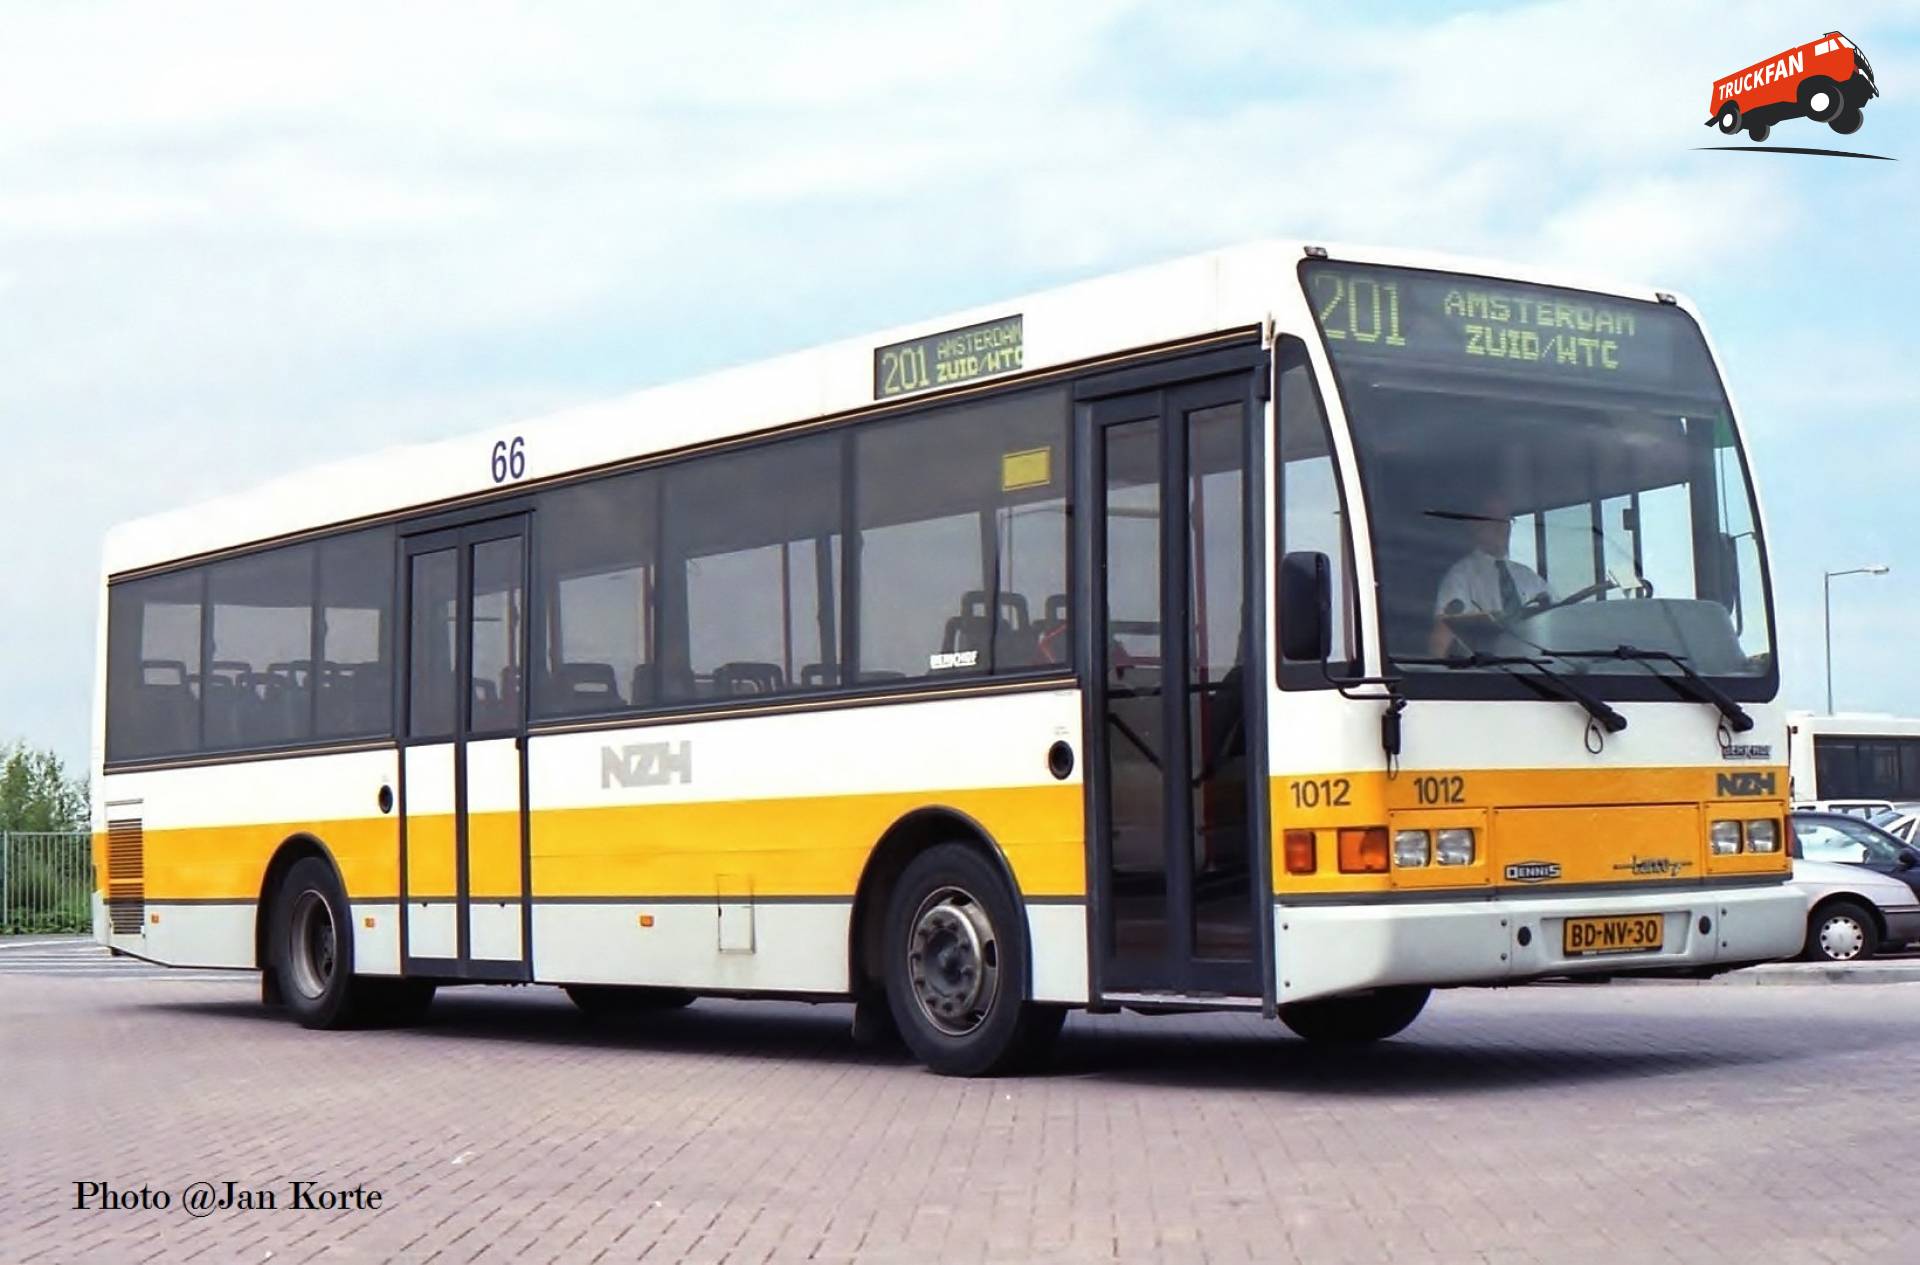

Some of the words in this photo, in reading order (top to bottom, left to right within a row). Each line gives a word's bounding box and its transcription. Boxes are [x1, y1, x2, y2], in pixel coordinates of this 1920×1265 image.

[1312, 270, 1406, 347] 201
[1443, 290, 1635, 336] AMSTERDAM
[882, 345, 930, 394] 201
[1464, 324, 1620, 370] ZUID/WTC
[491, 435, 525, 483] 66
[601, 740, 692, 788] NZH
[1717, 772, 1775, 796] NZH
[1290, 778, 1351, 808] 1012
[1413, 775, 1465, 804] 1012
[1505, 865, 1561, 879] DENNIS
[1571, 919, 1658, 947] BD-NV-30
